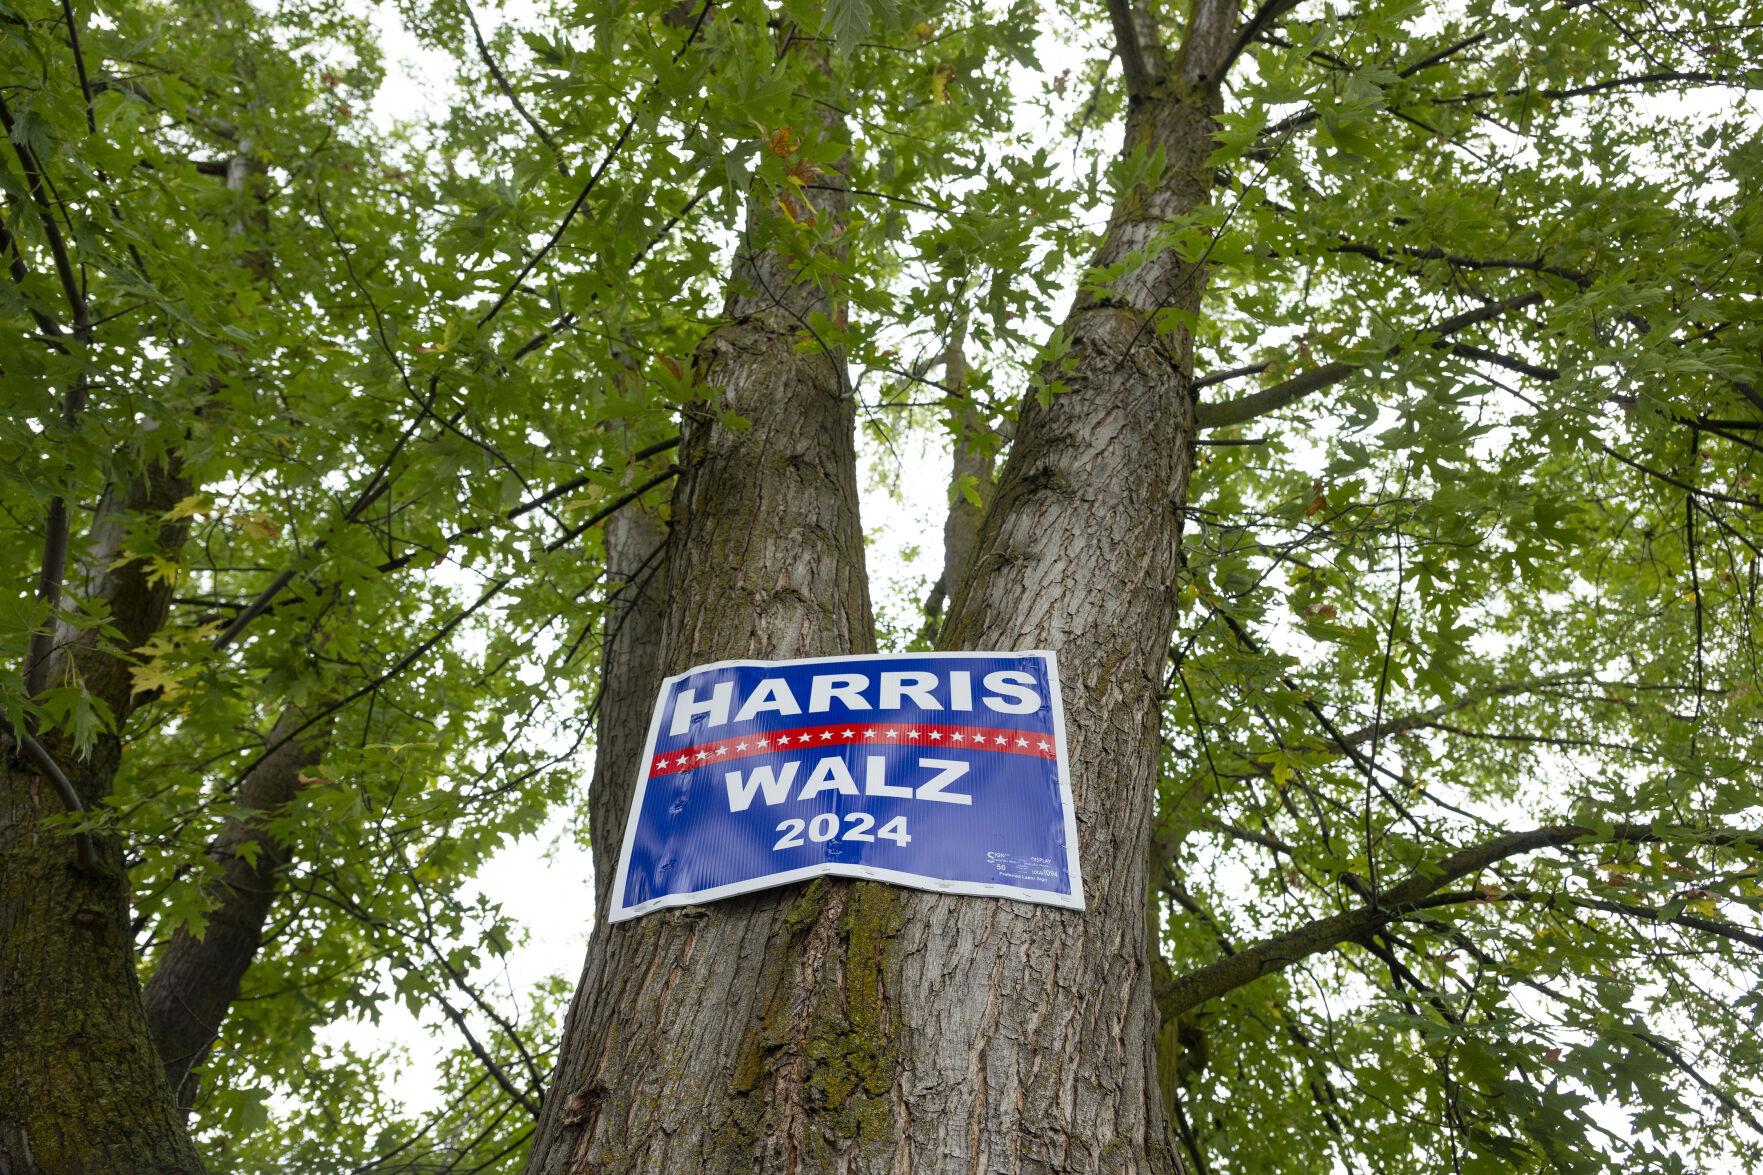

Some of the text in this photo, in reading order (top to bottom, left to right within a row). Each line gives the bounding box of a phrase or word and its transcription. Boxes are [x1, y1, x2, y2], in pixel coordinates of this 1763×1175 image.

[669, 670, 1042, 737] HARRIS
[725, 755, 973, 813] WALZ
[773, 812, 912, 851] 2024
